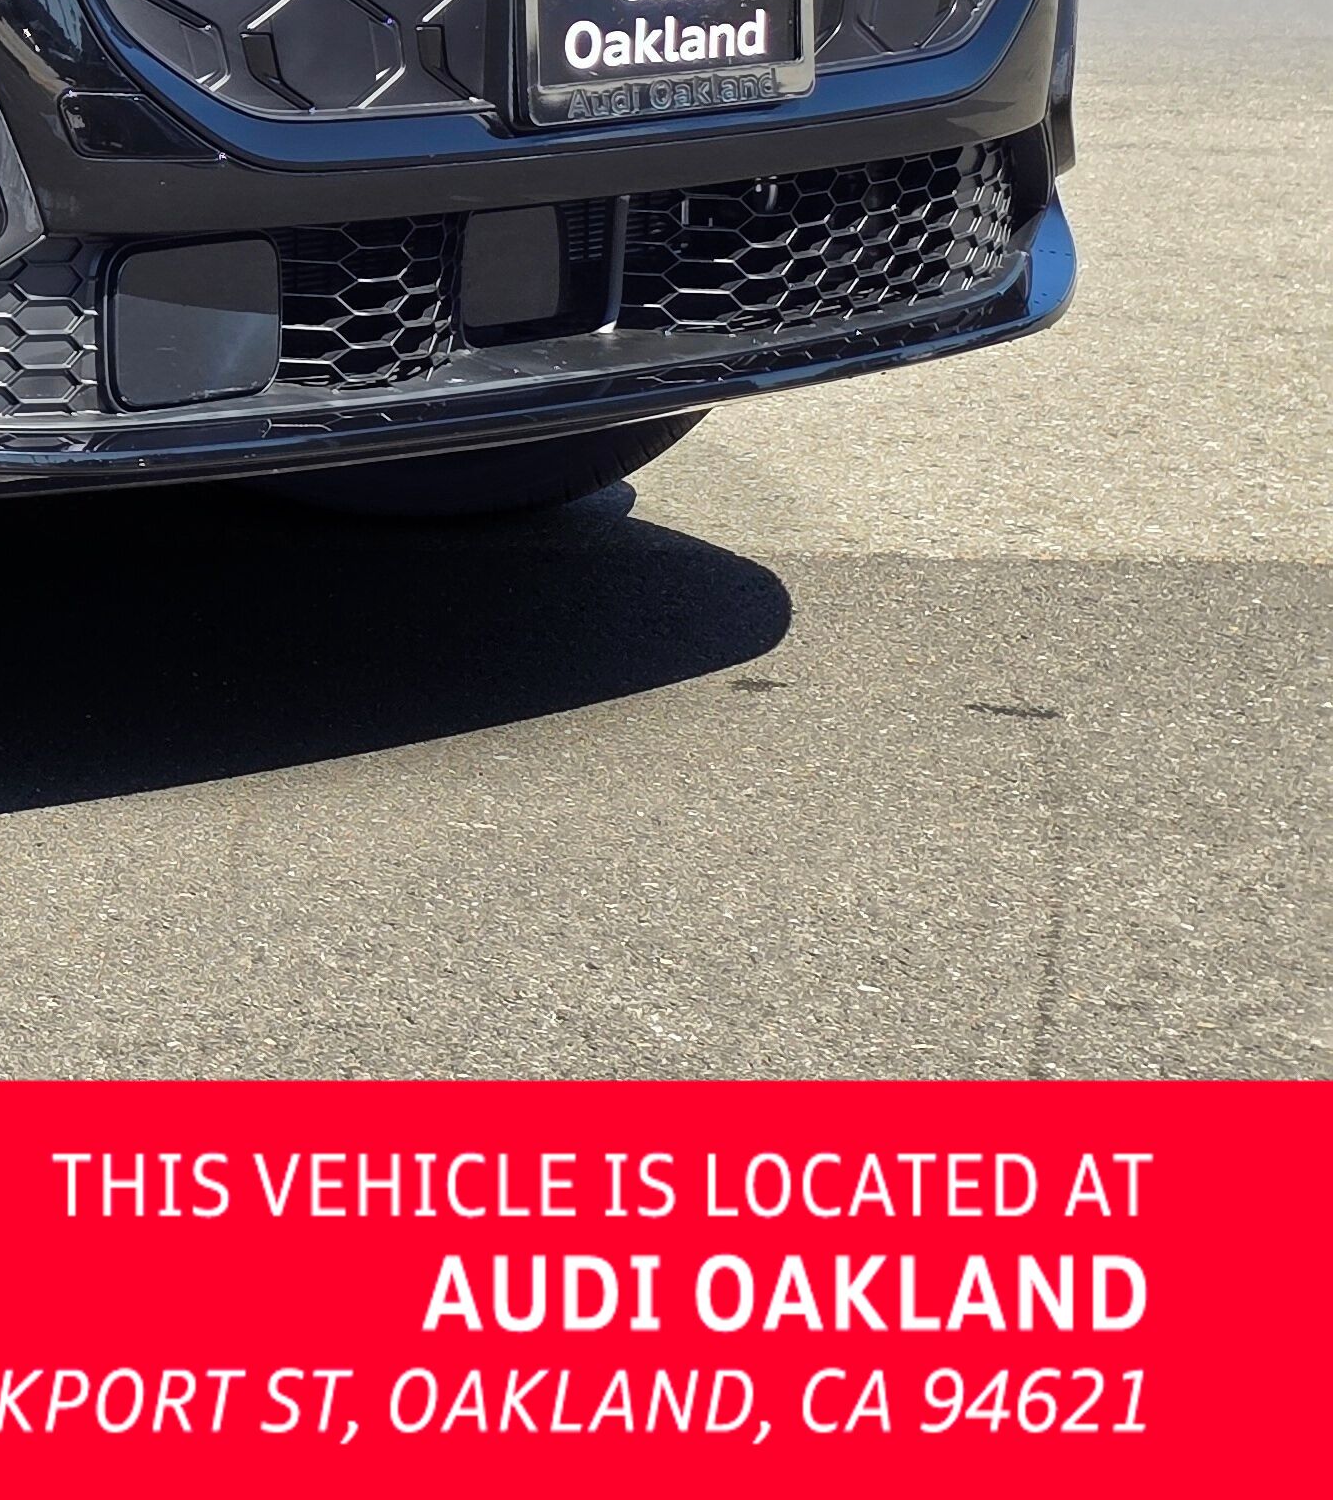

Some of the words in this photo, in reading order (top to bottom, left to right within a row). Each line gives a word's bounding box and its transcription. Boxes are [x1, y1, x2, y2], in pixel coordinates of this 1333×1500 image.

[564, 8, 767, 70] Oakland
[566, 82, 641, 120] Audi
[649, 67, 780, 110] Oakland
